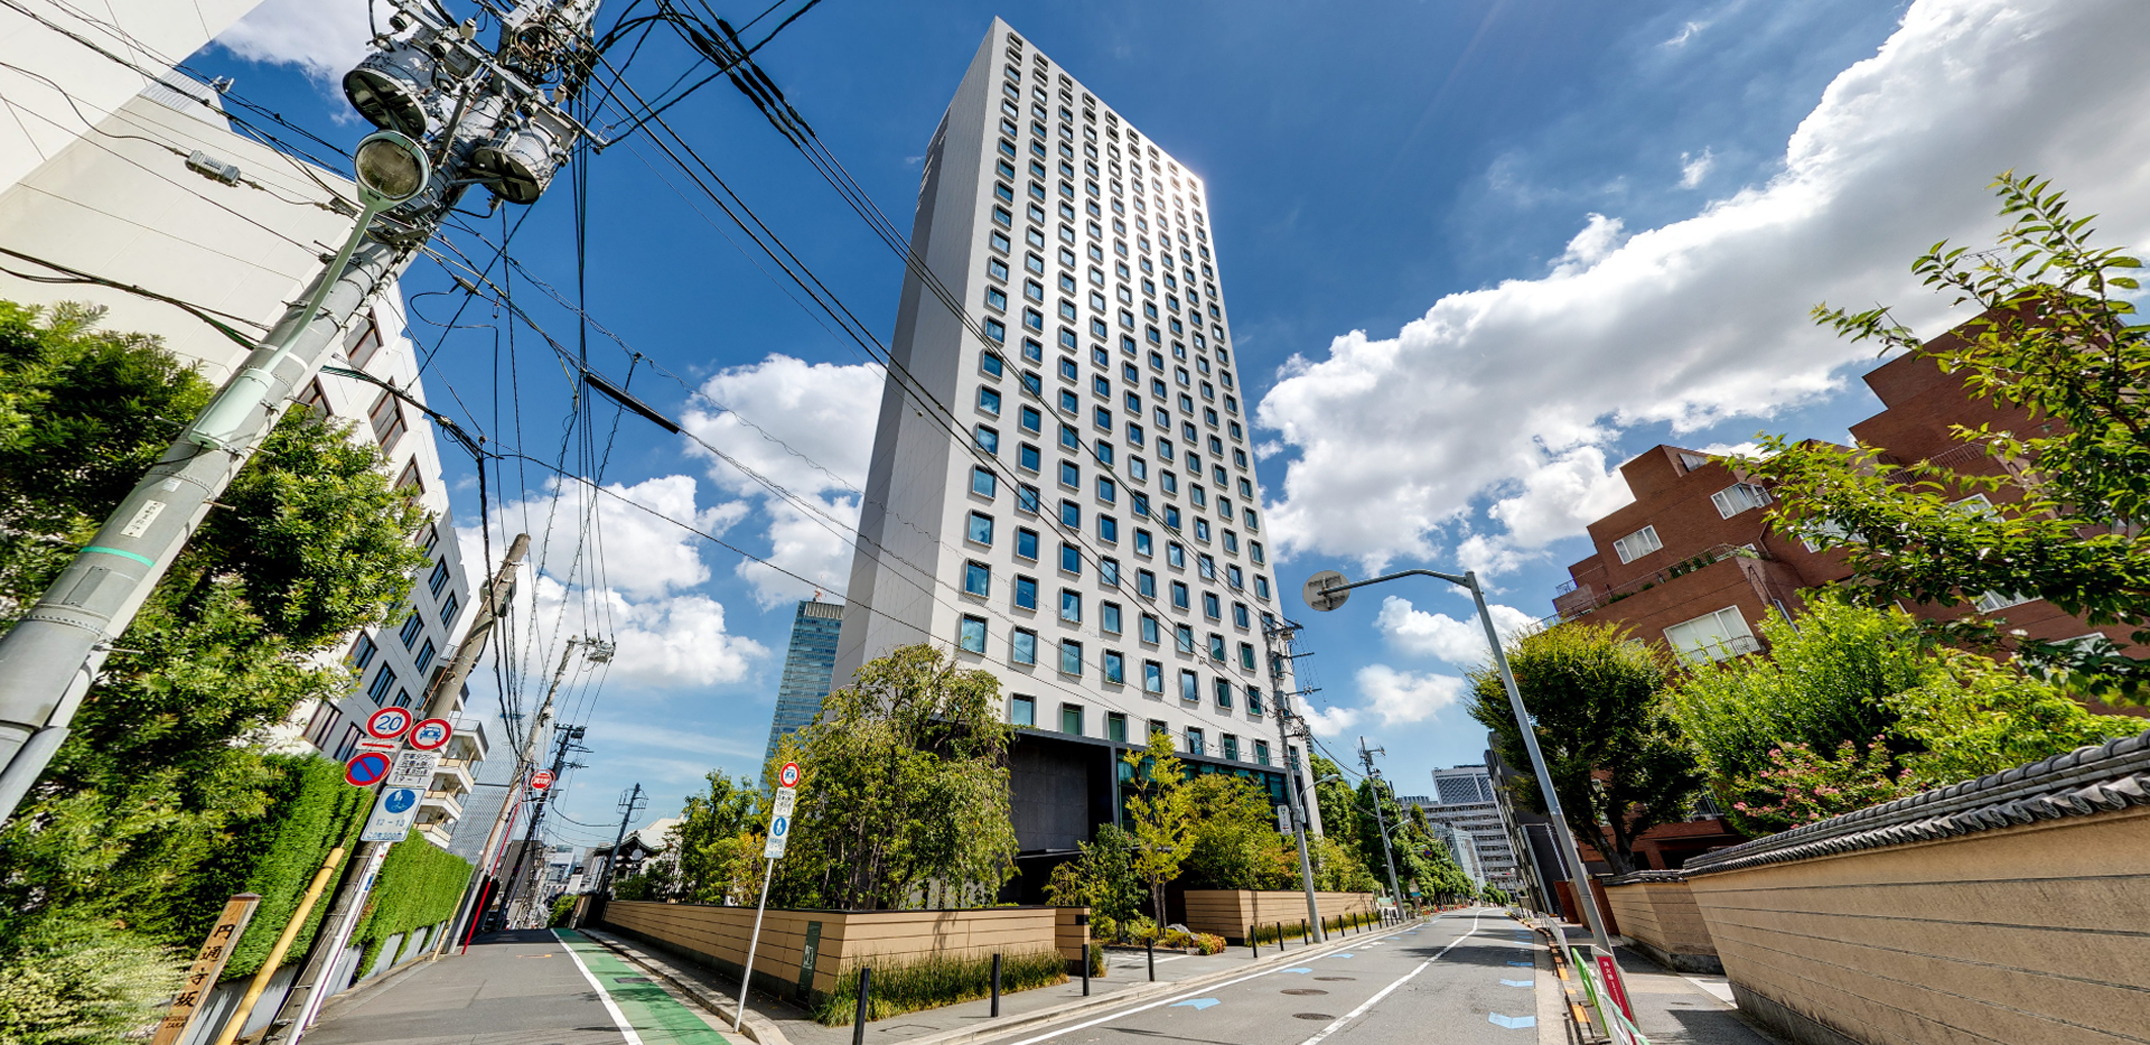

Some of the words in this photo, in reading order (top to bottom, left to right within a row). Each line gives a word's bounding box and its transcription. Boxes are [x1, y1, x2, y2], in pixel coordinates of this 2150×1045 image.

[375, 715, 403, 731] 20
[174, 923, 236, 1007] 円通寺坂
